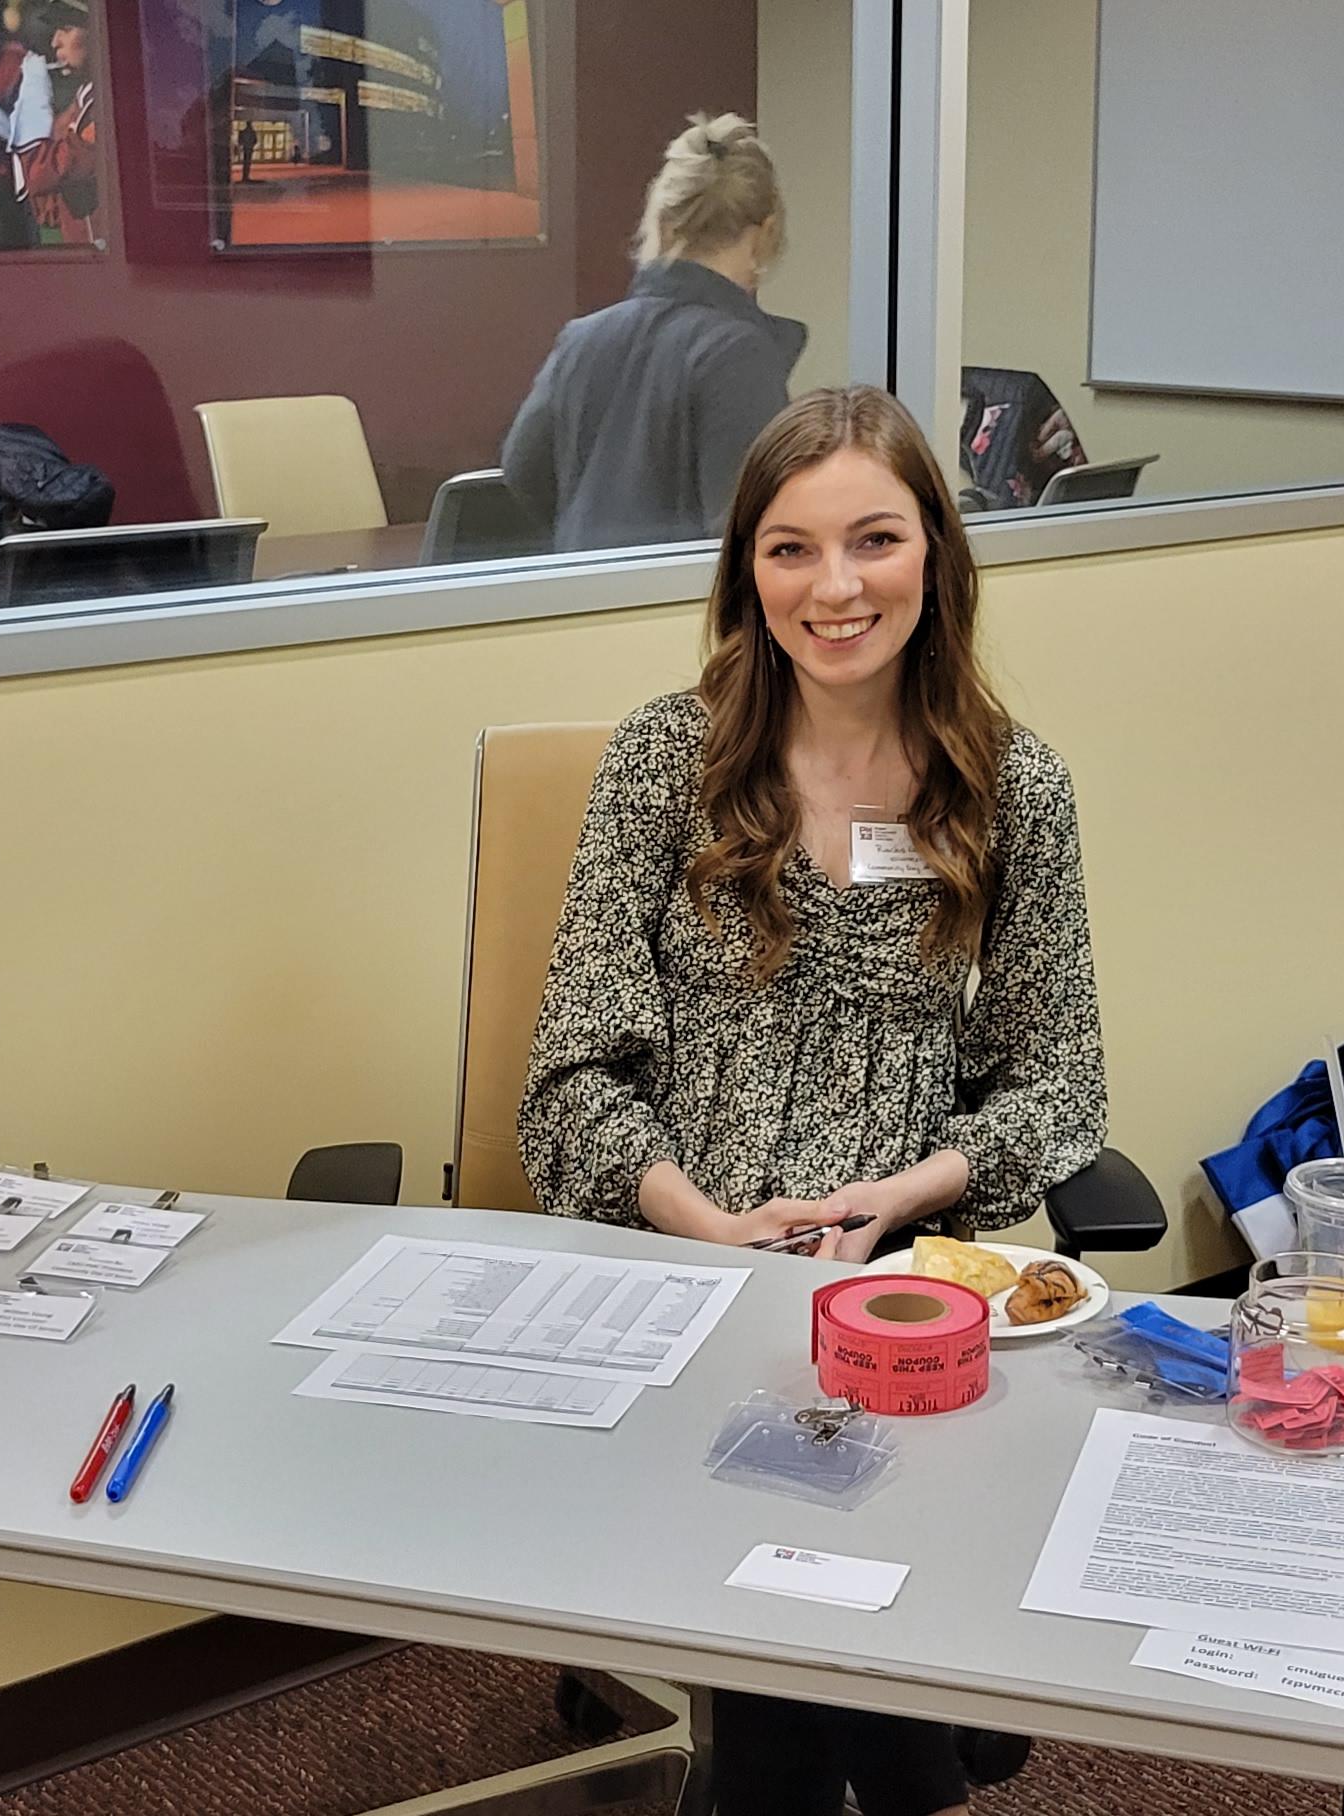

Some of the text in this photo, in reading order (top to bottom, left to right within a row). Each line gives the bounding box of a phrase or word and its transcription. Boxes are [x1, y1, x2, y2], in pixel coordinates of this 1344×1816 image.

[892, 1363, 945, 1373] KEEP THIS
[897, 1356, 940, 1366] COUPON
[898, 1399, 939, 1413] TICKET
[1196, 1633, 1281, 1657] Guest Wi-Fi
[1191, 1645, 1234, 1661] Login:
[1184, 1657, 1259, 1680] Password:
